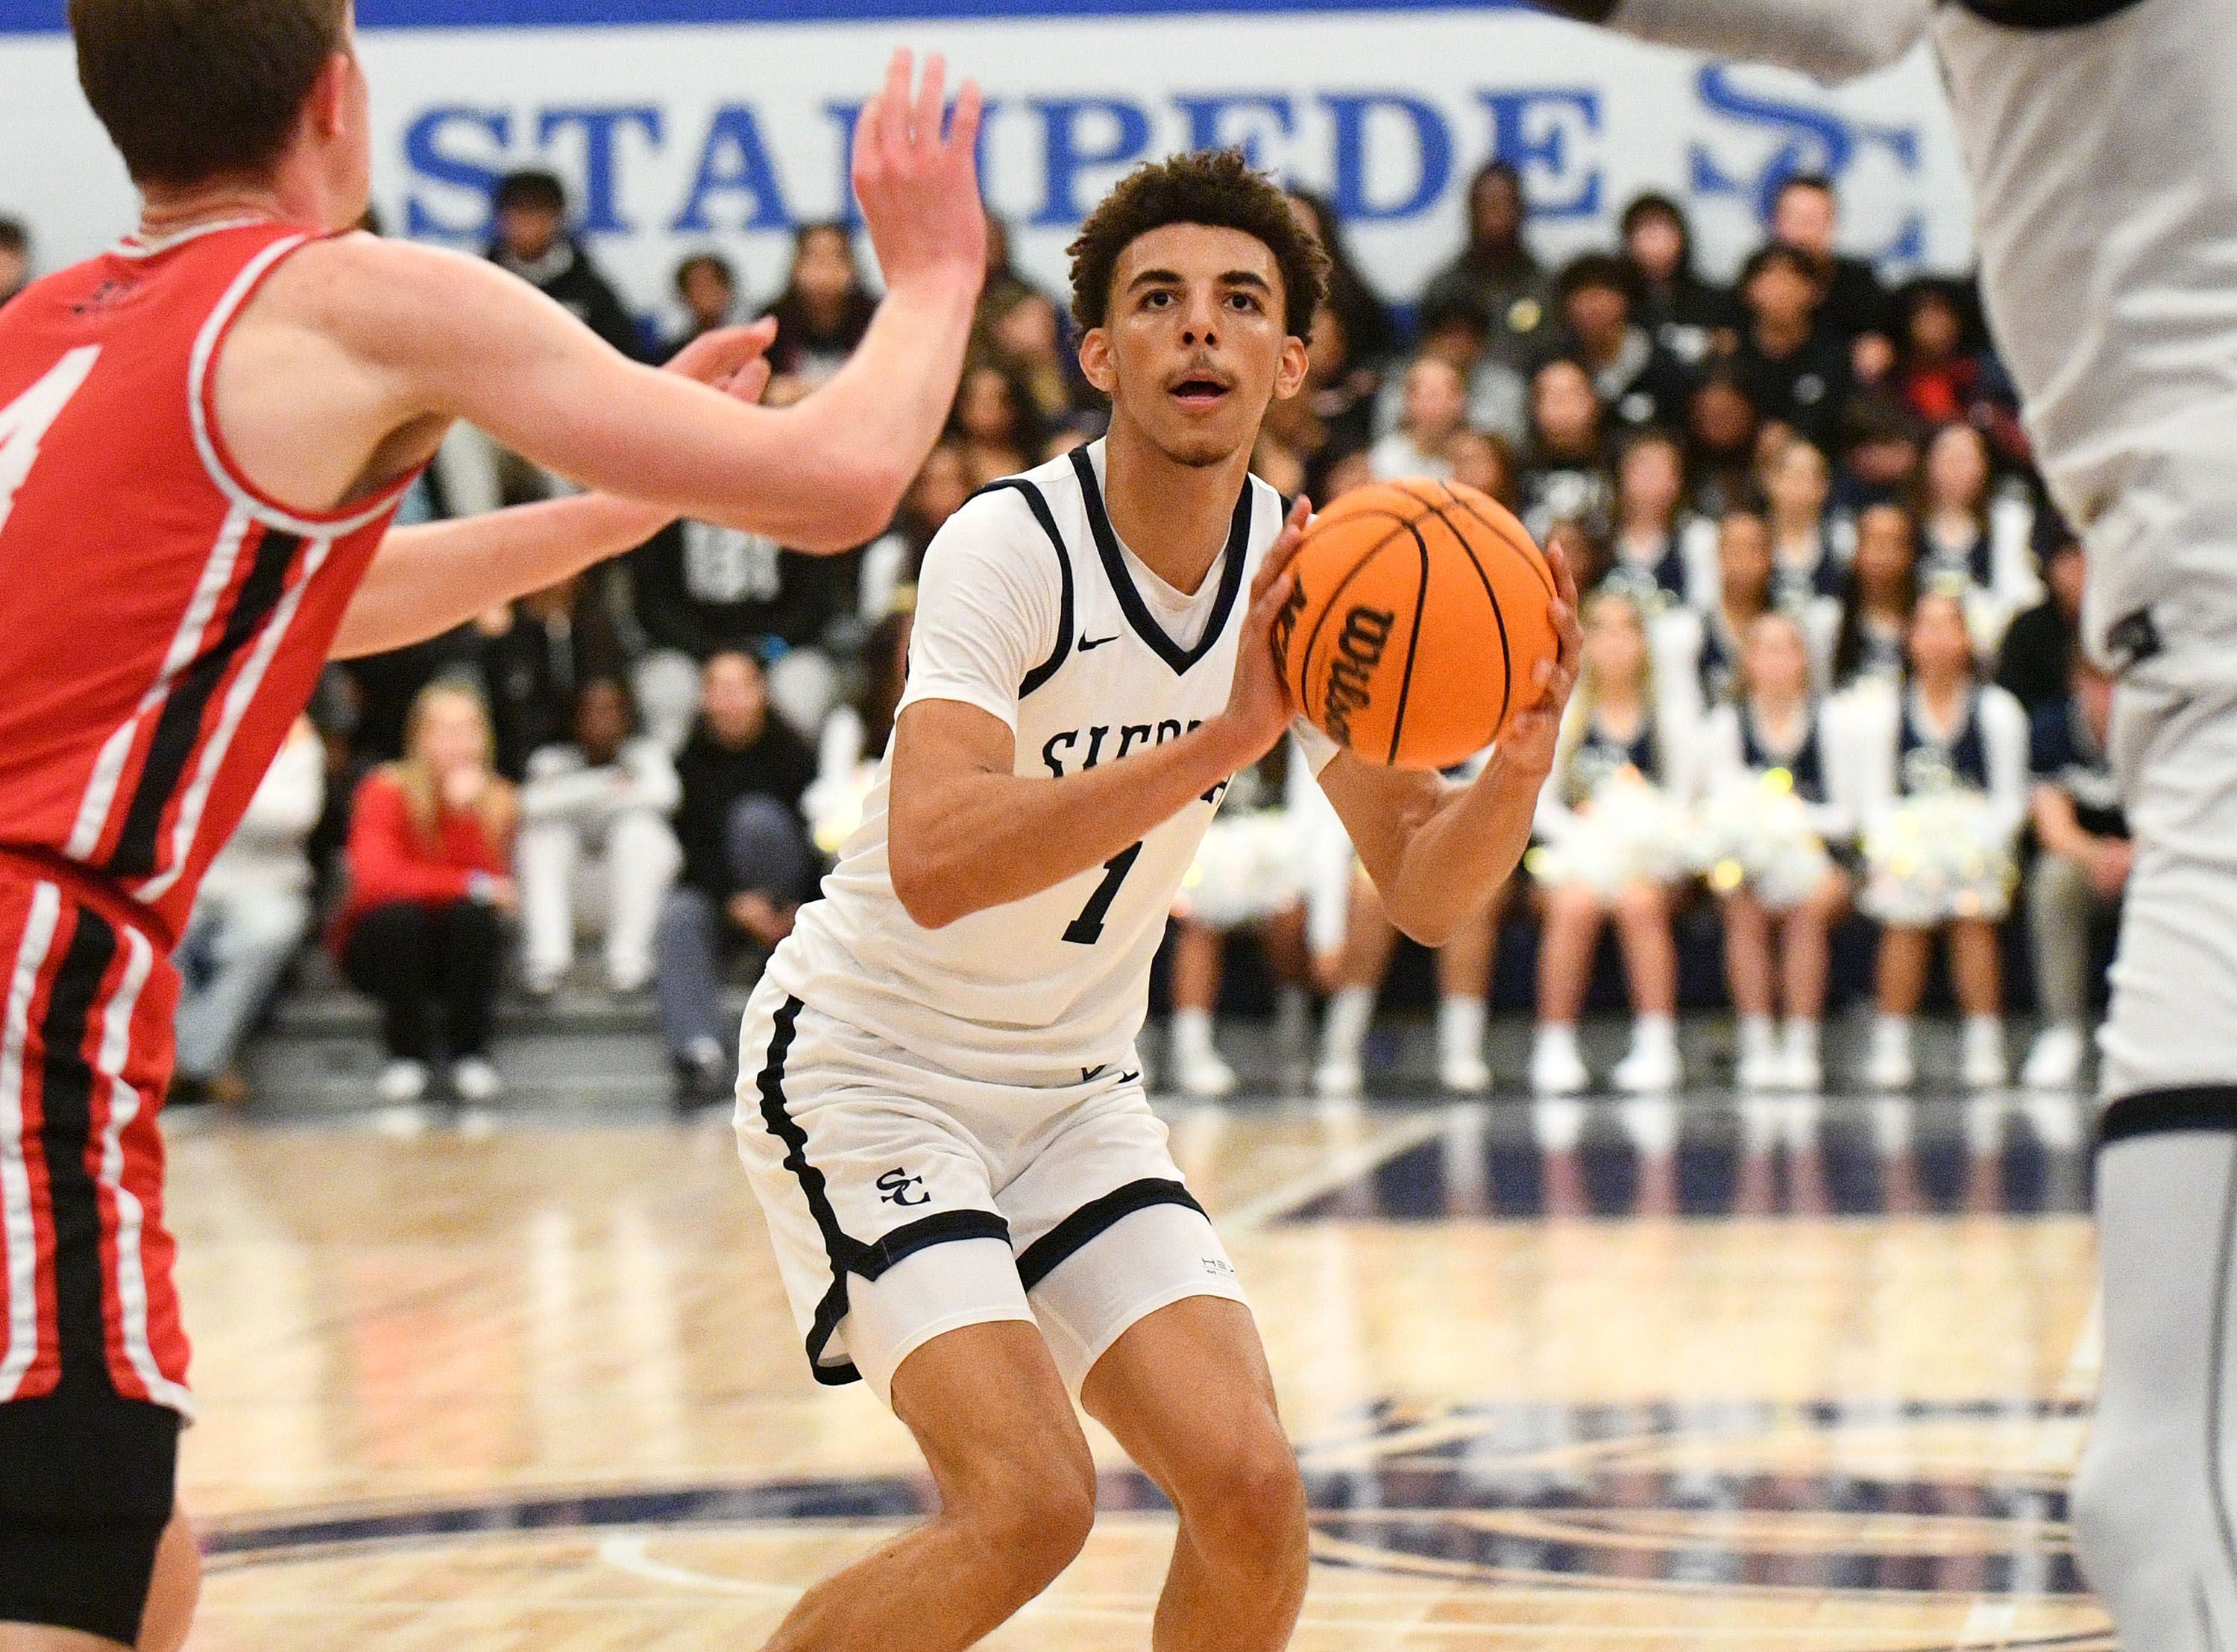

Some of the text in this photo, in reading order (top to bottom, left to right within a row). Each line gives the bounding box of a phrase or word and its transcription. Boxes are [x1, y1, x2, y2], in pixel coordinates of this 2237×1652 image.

[1324, 605, 1394, 750] Wils
[1042, 719, 1228, 804] SIER
[1061, 841, 1143, 945] 1
[876, 1167, 931, 1205] SC
